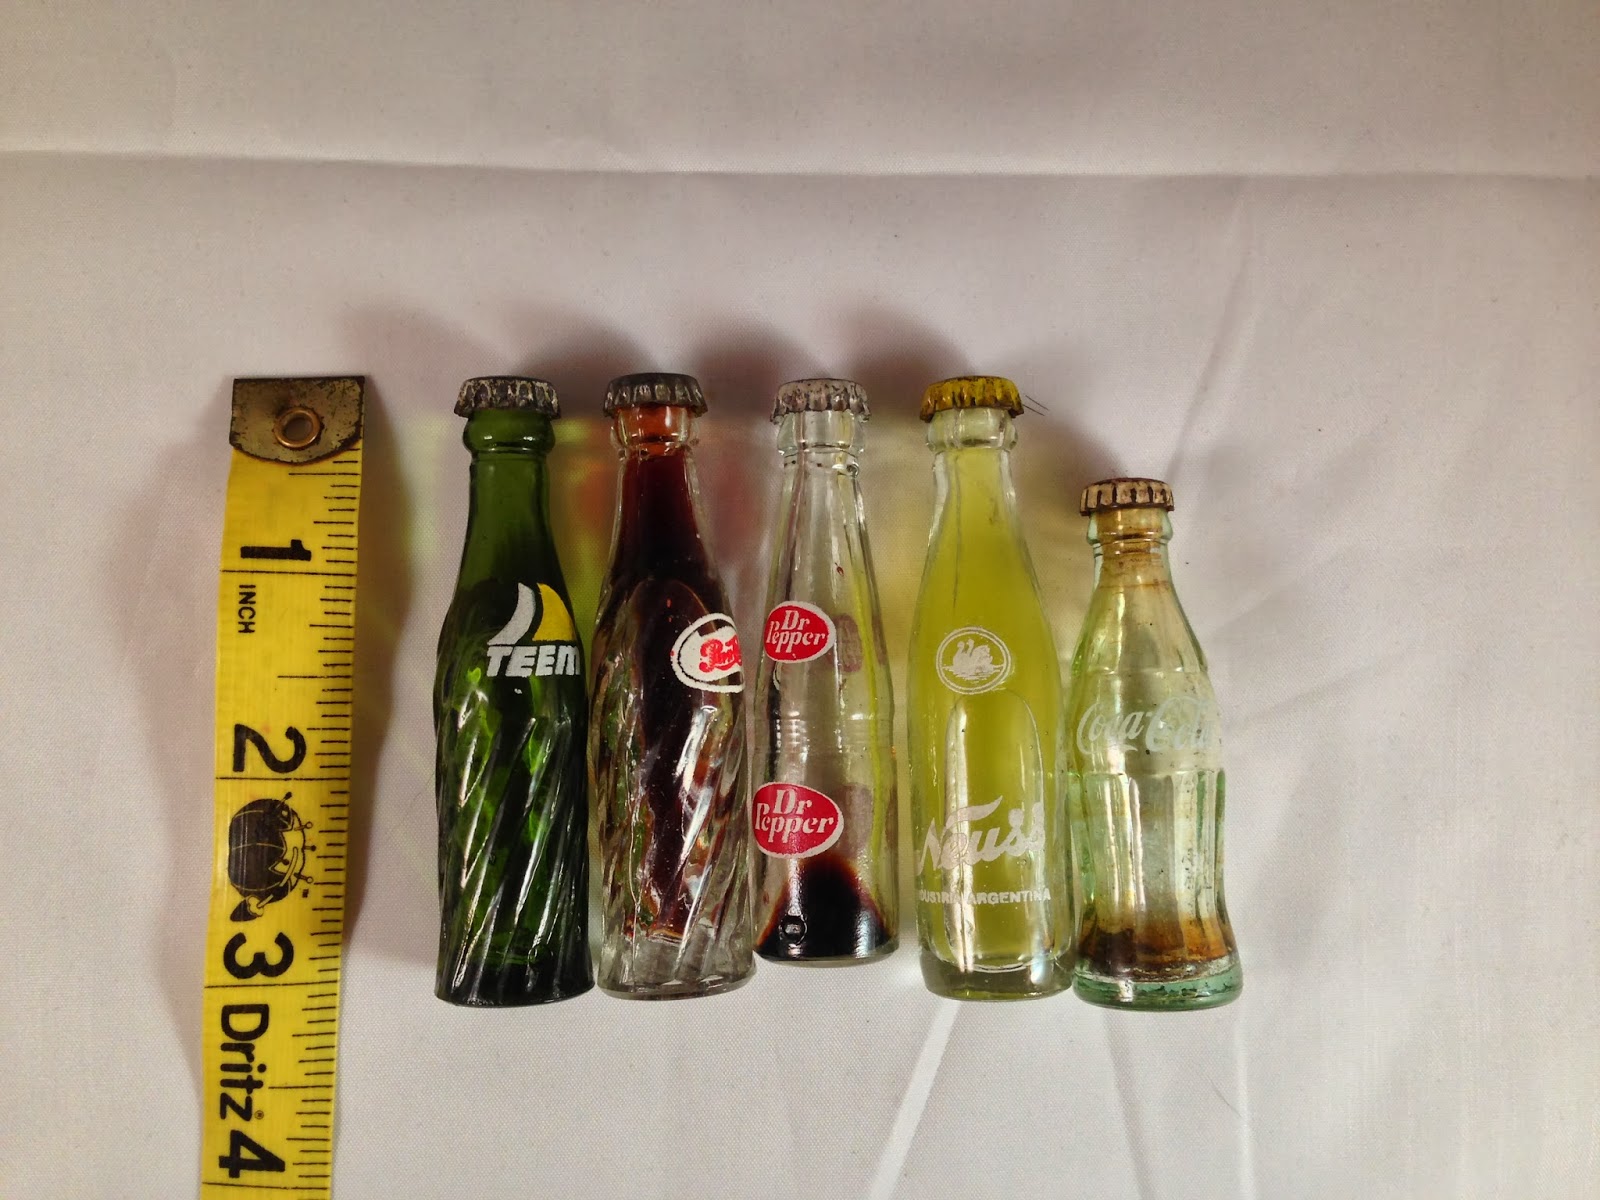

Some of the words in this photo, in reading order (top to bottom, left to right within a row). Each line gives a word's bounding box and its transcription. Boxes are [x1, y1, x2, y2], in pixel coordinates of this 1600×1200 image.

[240, 539, 312, 561] 1
[238, 584, 257, 634] INCH
[781, 609, 811, 631] Dr
[765, 620, 826, 654] Pepper
[486, 645, 581, 678] TEEM
[232, 723, 307, 774] 2
[773, 788, 812, 815] Dr
[755, 802, 835, 844] Pepper
[966, 887, 1052, 905] ARGENTINA
[223, 931, 294, 980] 3
[219, 1003, 270, 1123] Dritz
[218, 1129, 286, 1179] 4
